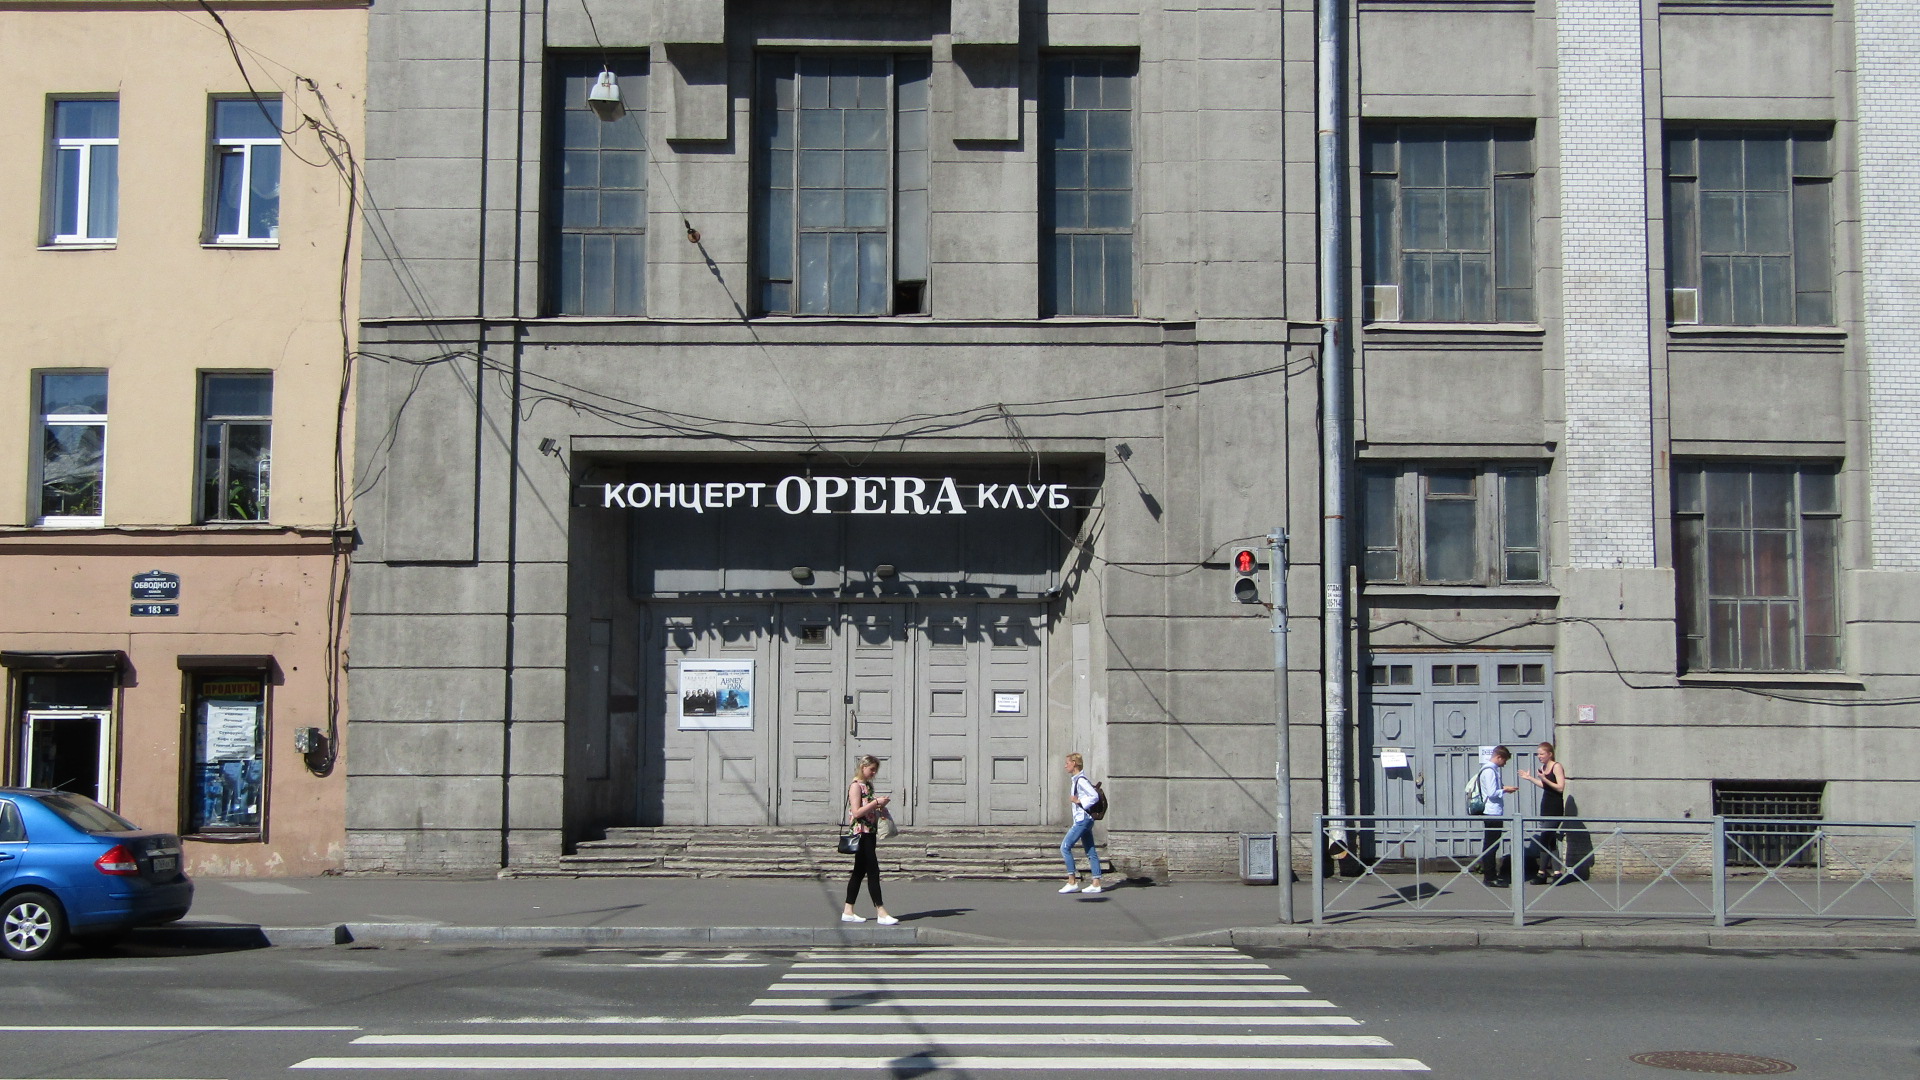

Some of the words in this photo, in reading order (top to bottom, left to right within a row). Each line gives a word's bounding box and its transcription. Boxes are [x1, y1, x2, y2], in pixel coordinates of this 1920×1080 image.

[603, 482, 767, 514] КОНЦЕРТ
[775, 475, 967, 515] OPERA
[978, 483, 1070, 510] КЛУБ
[134, 581, 177, 590] ОБВОДНОГО
[148, 605, 162, 614] 183
[204, 683, 259, 695] ПРОДУКТЫ
[727, 683, 746, 691] PARK
